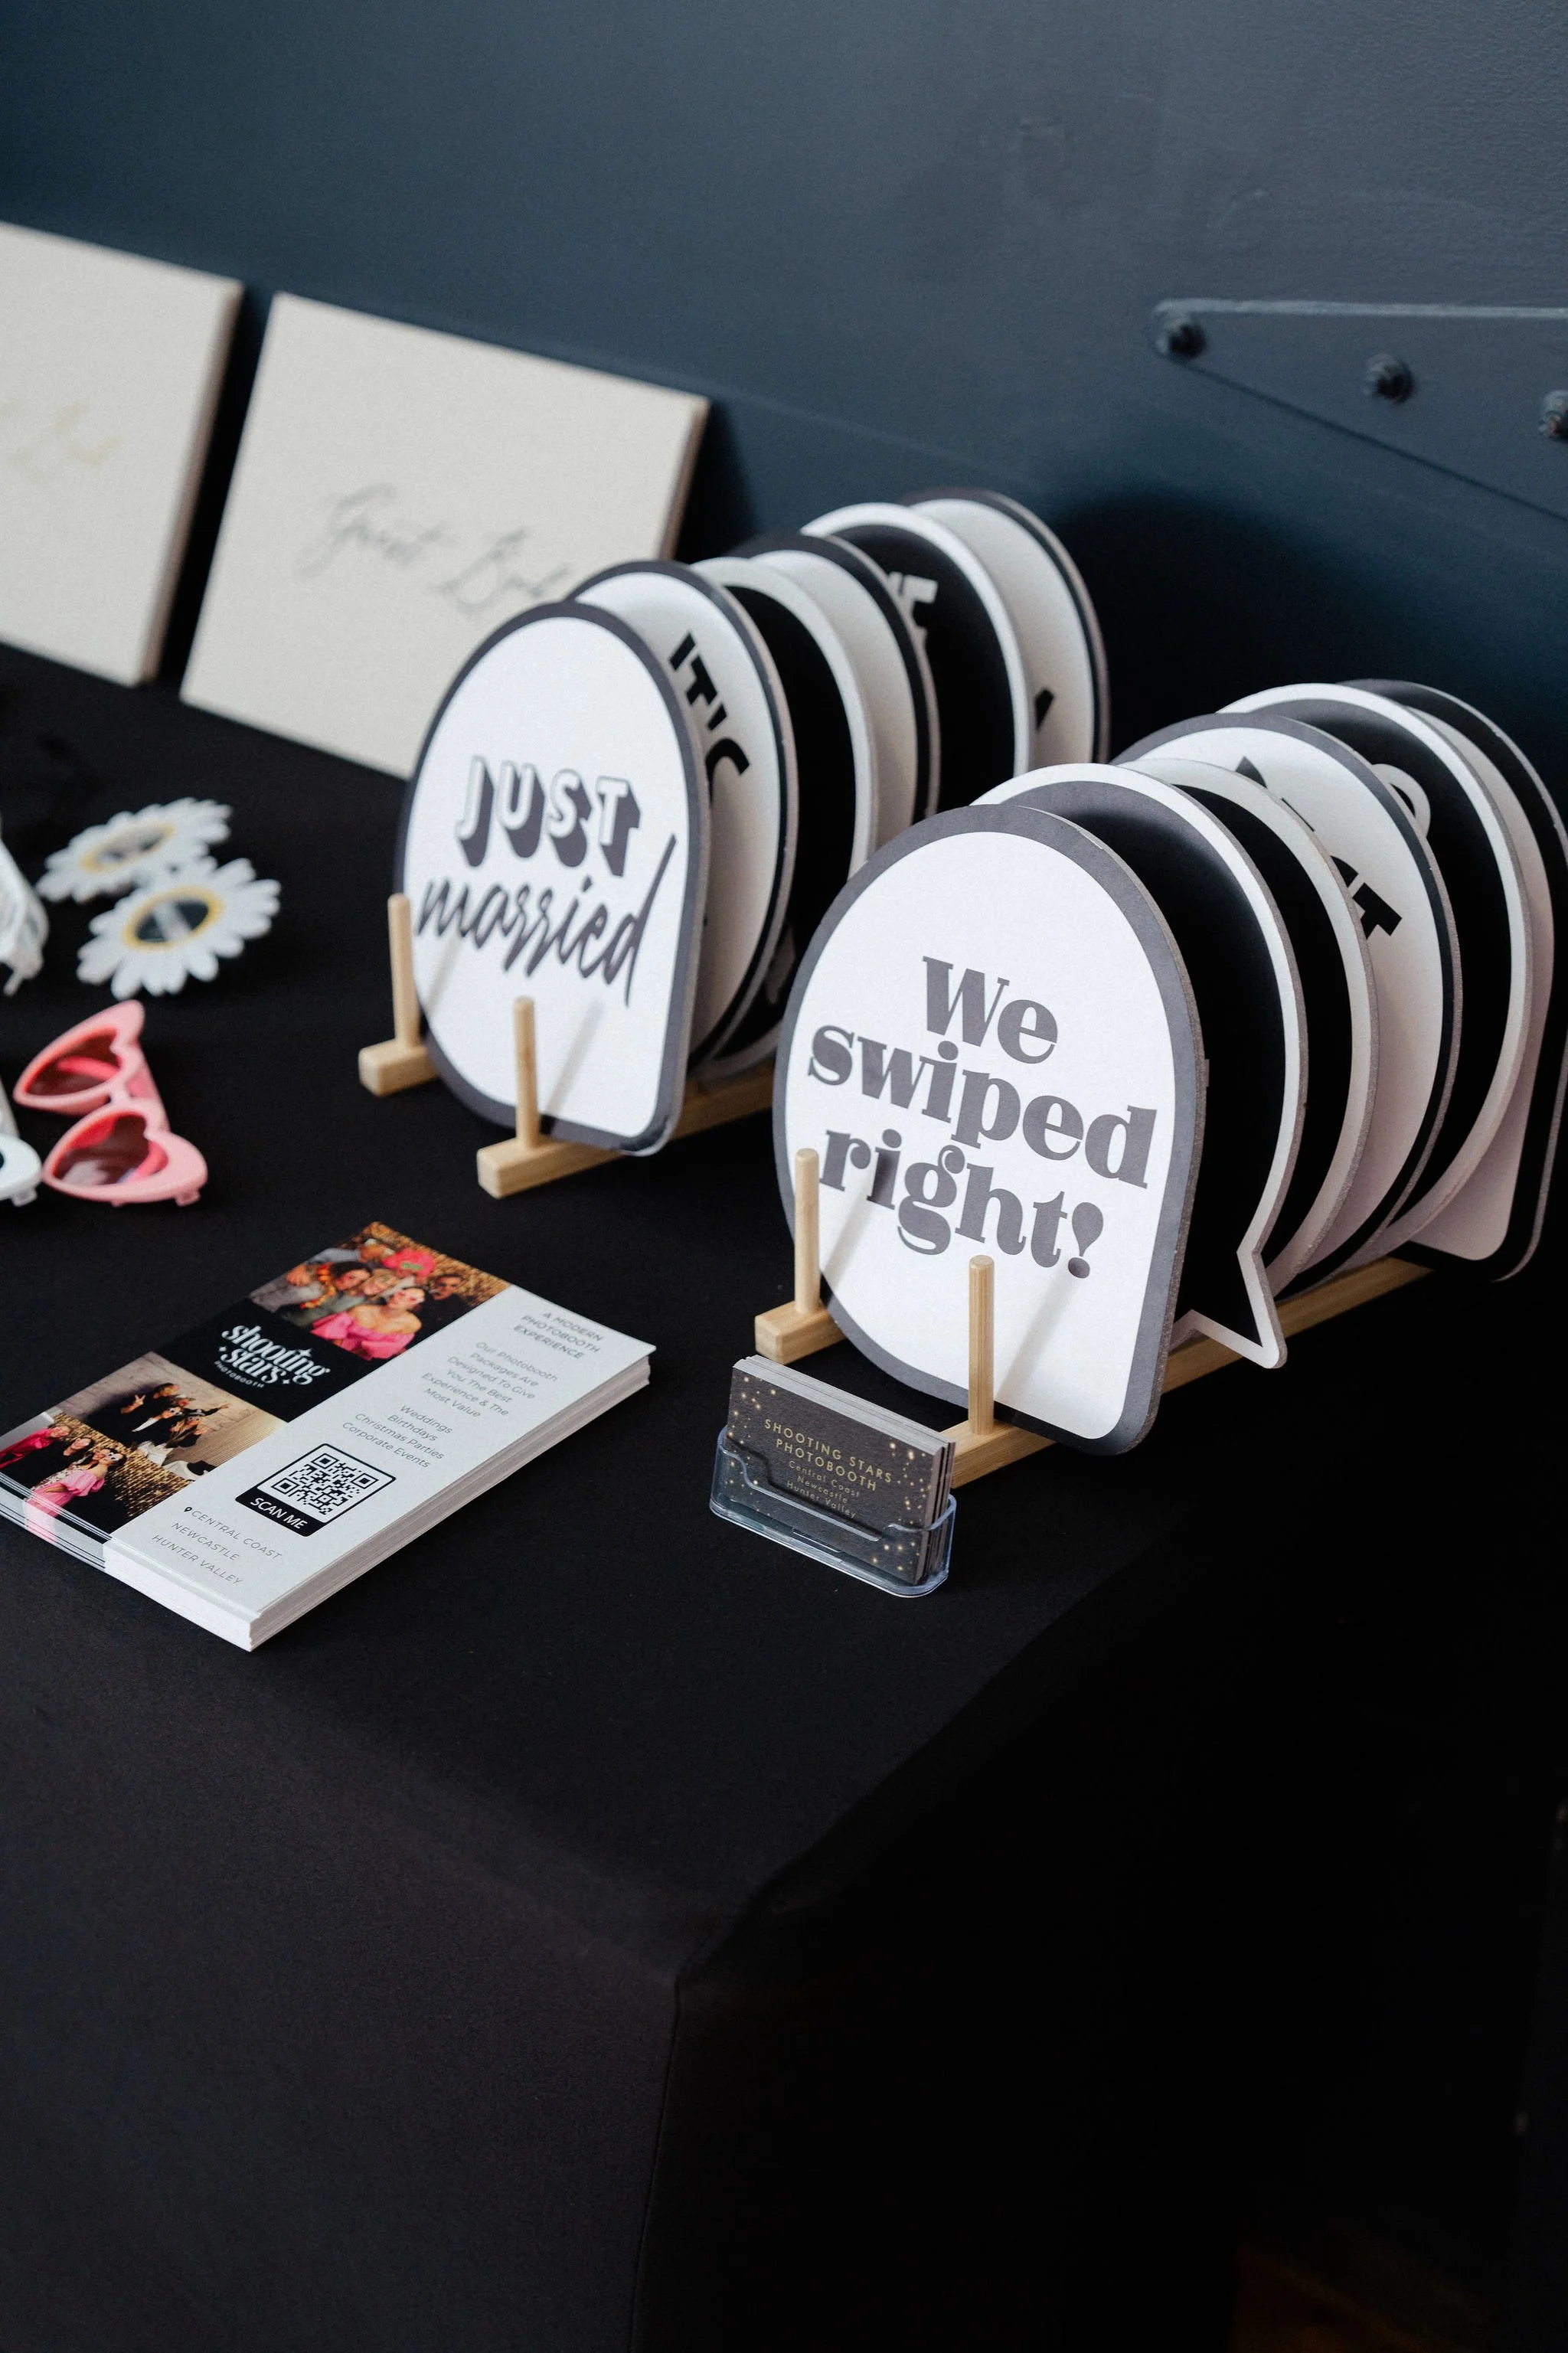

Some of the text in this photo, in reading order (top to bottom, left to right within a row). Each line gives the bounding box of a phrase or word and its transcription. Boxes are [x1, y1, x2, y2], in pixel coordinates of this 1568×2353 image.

[456, 754, 642, 877] JUST
[415, 834, 677, 1008] married
[923, 955, 1058, 1064] We
[808, 1023, 1158, 1190] swiped
[818, 1129, 1105, 1279] right!
[513, 1324, 586, 1359] EXPERIENCE
[521, 1315, 601, 1353] PHOTOBOOTH
[553, 1316, 604, 1342] MODERN
[220, 1325, 331, 1385] shooting
[220, 1348, 287, 1384] stars
[469, 1352, 540, 1387] Packages Are
[475, 1342, 559, 1383] Our Photobooth
[422, 1372, 510, 1416] Experience & The
[446, 1356, 536, 1400] Designed To Give
[446, 1369, 514, 1404] You The Best
[400, 1405, 453, 1433] Weddings
[424, 1388, 482, 1418] Most Value
[342, 1422, 431, 1469] Corporate Events
[354, 1413, 446, 1460] Christmas Parties
[387, 1414, 439, 1442] Birthdays
[764, 1418, 893, 1484] SHOOTING STARS
[776, 1438, 877, 1492] PHOTOBOOTH
[786, 1480, 857, 1519] Hunter Valley
[788, 1460, 861, 1498] Central Coast
[797, 1475, 849, 1505] Newcastle
[250, 1497, 309, 1530] SCAN ME
[171, 1522, 241, 1561] NEWCASTLE
[191, 1510, 283, 1560] CENTRAL COAST
[152, 1534, 244, 1585] HUNTER VALLEY
